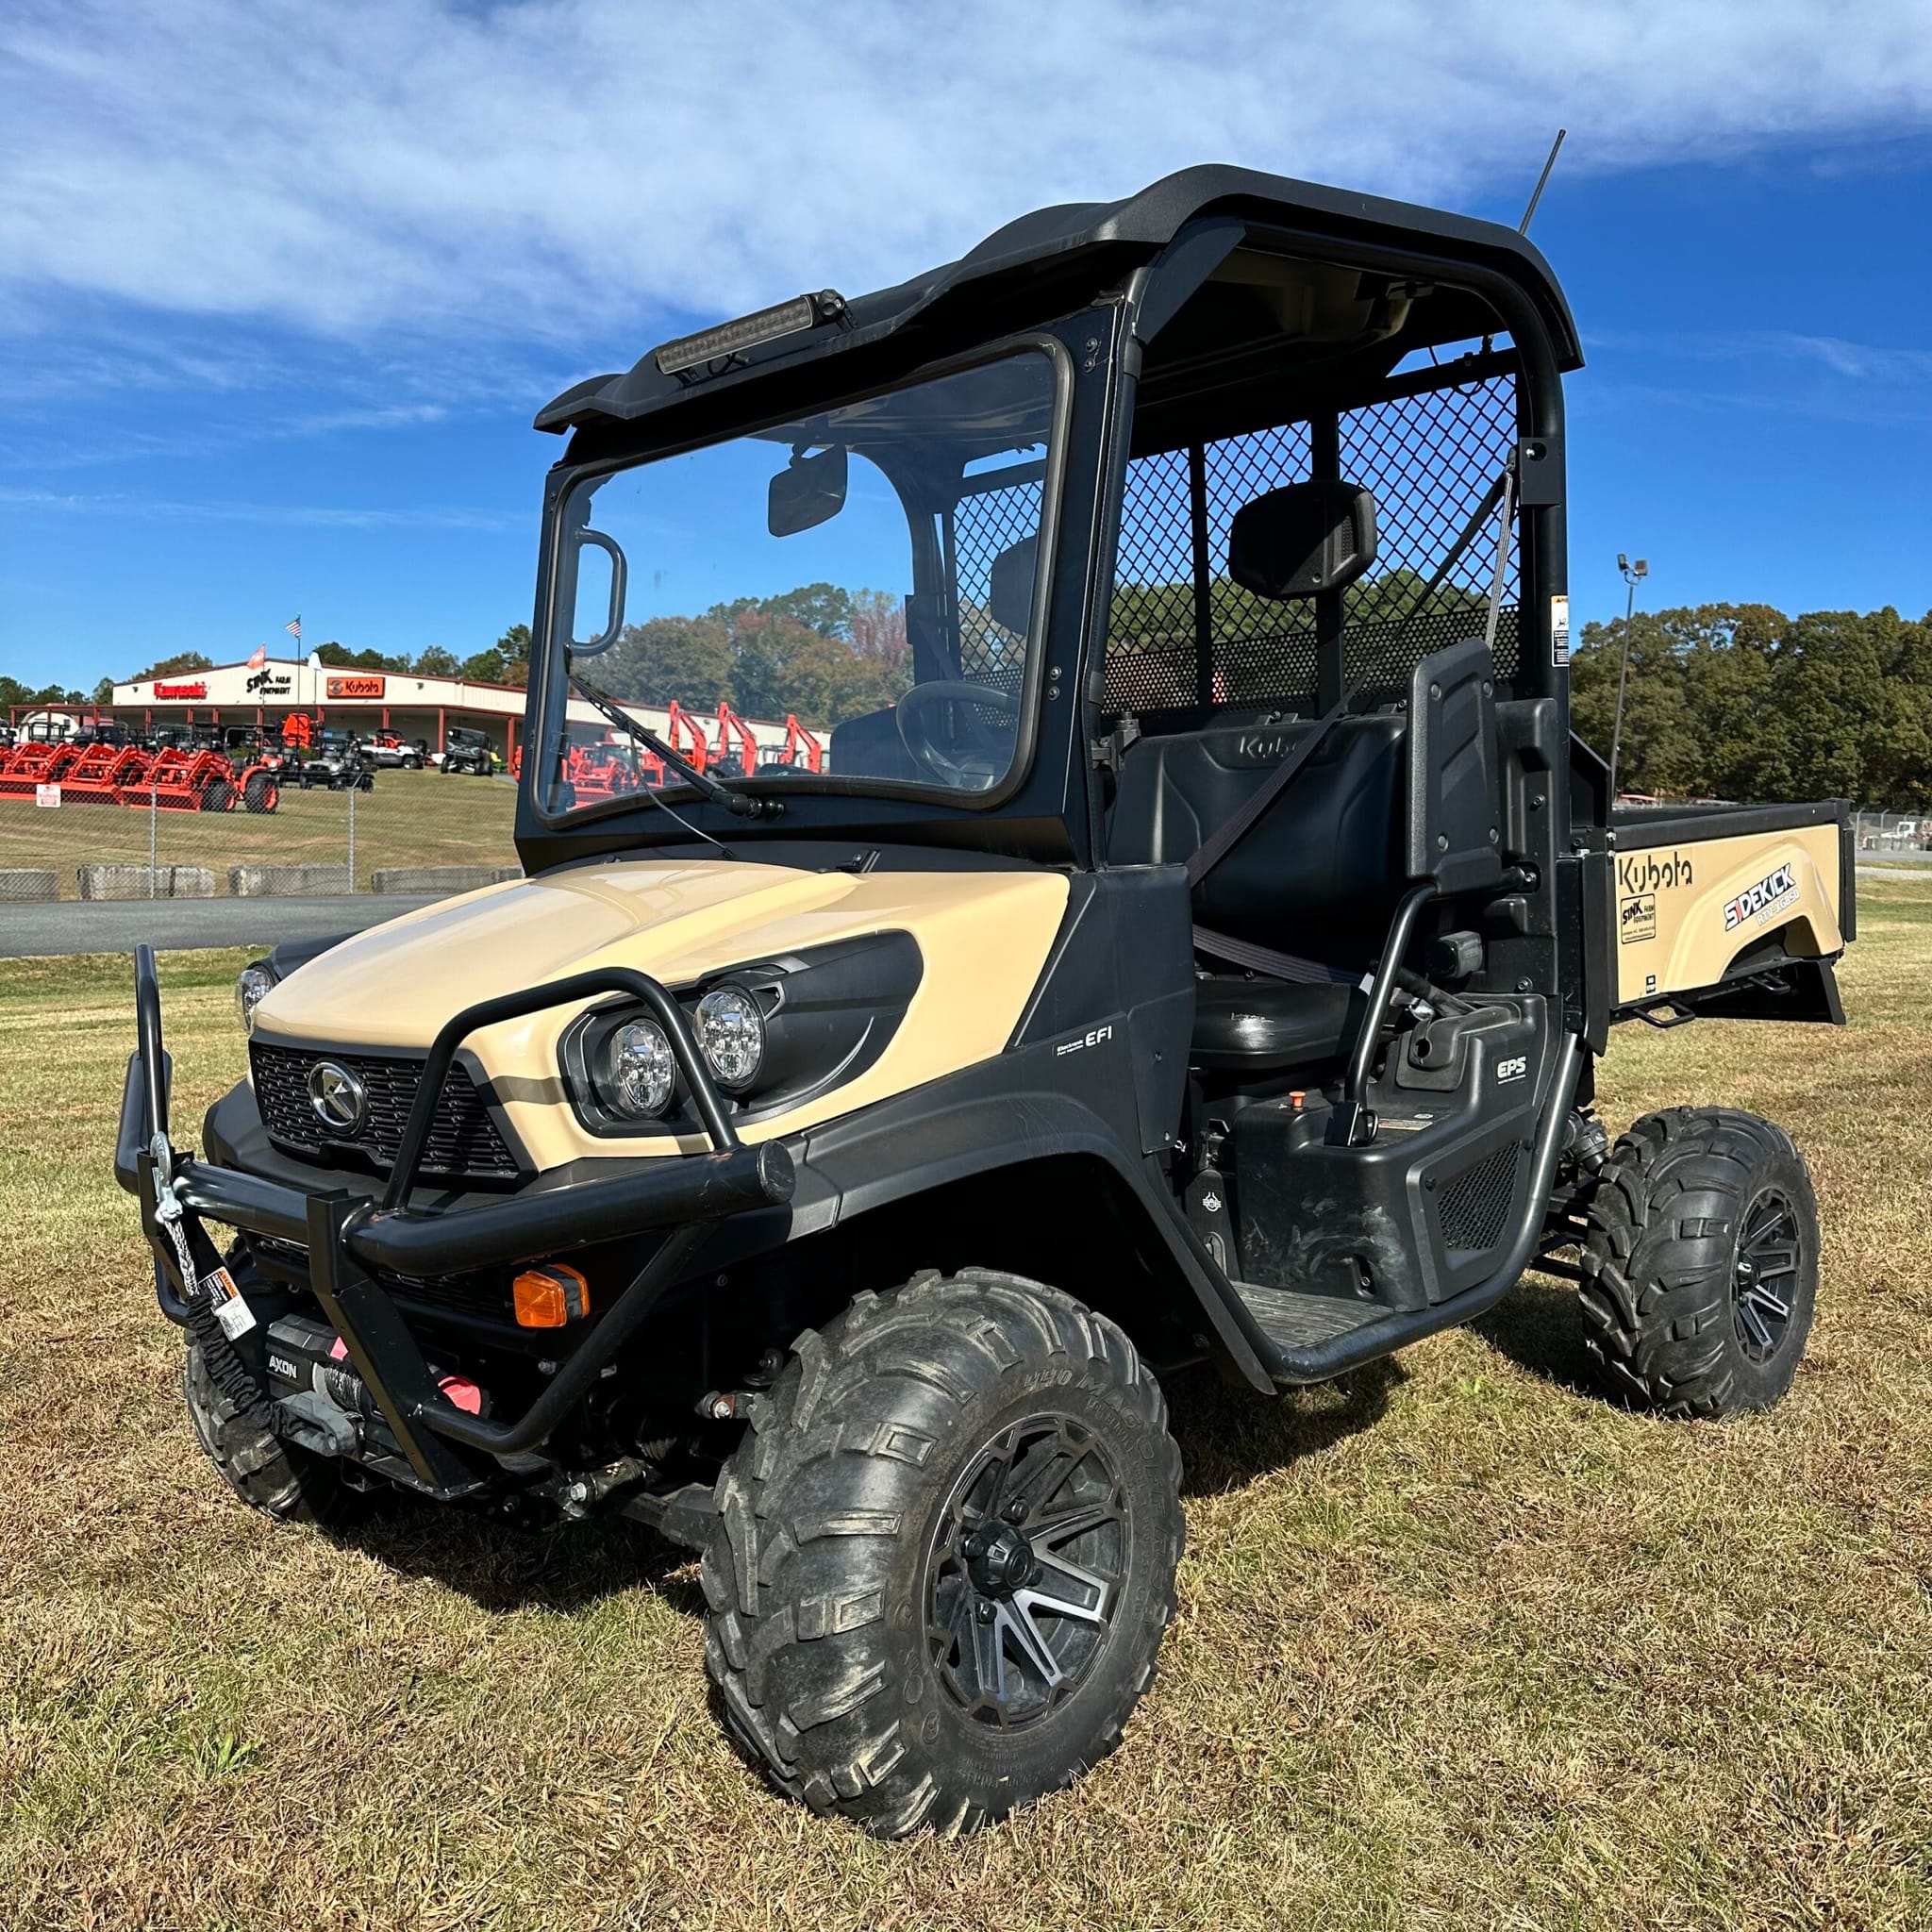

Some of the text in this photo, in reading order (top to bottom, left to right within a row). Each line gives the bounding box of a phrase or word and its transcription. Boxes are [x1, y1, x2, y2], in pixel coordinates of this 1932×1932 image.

[345, 679, 379, 693] Kubota
[1618, 851, 1693, 894] Kubota
[1724, 862, 1796, 932] SIDEKICK
[1623, 899, 1643, 925] SINK
[1086, 1025, 1111, 1046] EFI
[1497, 1056, 1526, 1078] EPS
[268, 1355, 297, 1379] AXON
